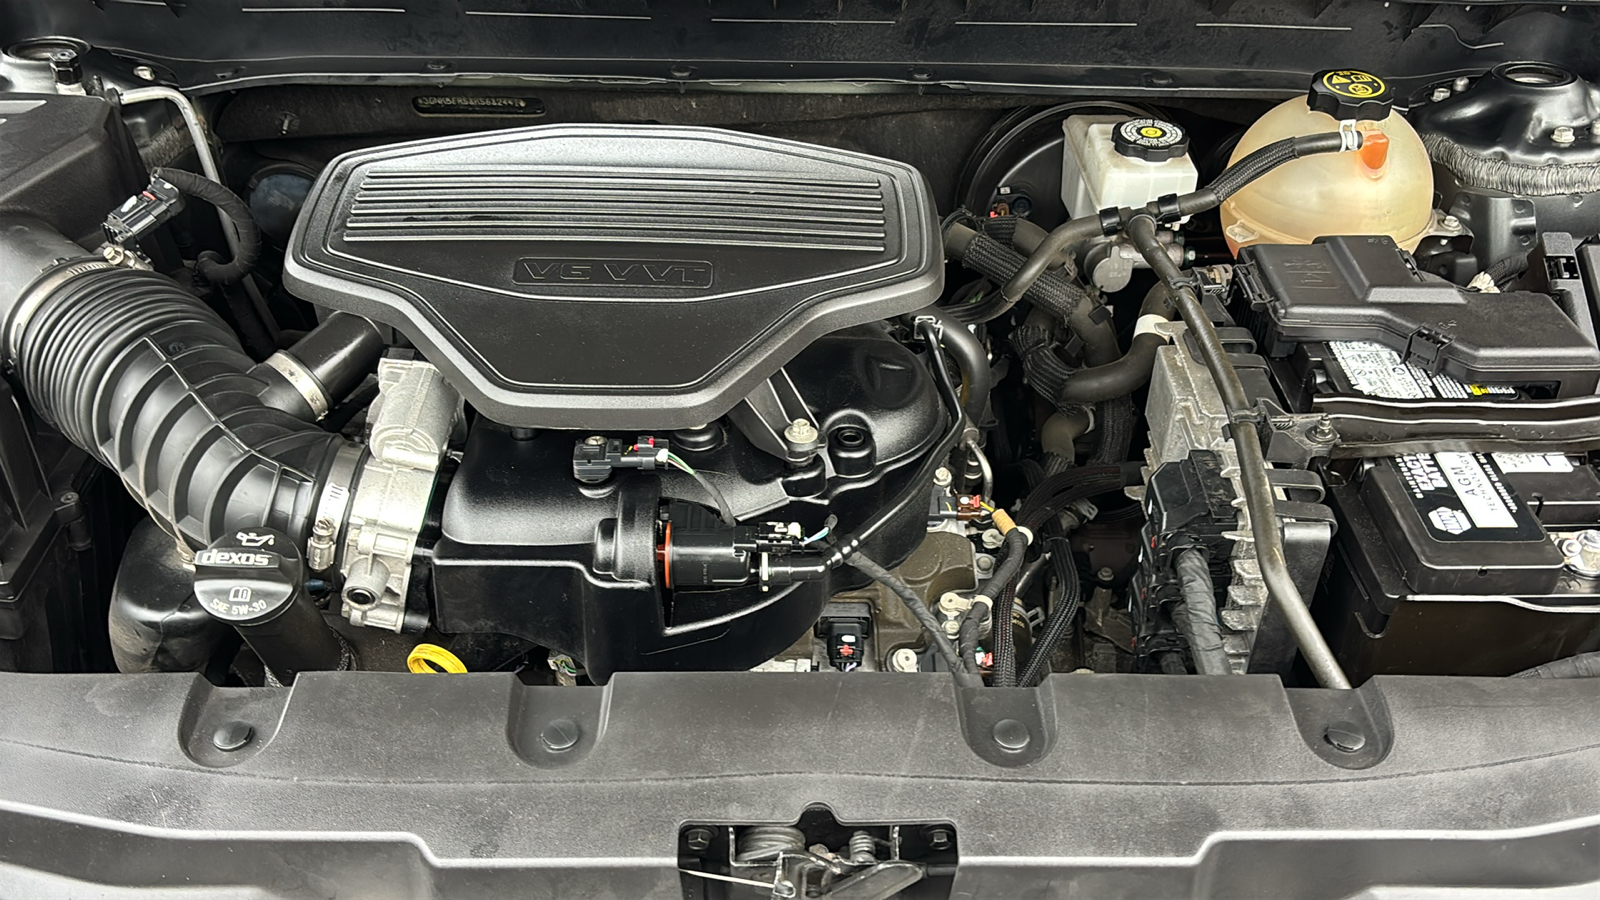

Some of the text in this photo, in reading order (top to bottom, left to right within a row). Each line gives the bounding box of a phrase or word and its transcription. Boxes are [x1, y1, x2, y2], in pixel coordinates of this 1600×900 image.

[523, 262, 706, 283] V6 VVT
[1415, 452, 1448, 488] BATTE
[1450, 466, 1479, 496] AGM
[201, 548, 272, 566] dexos
[210, 599, 267, 615] SAE 5W-30
